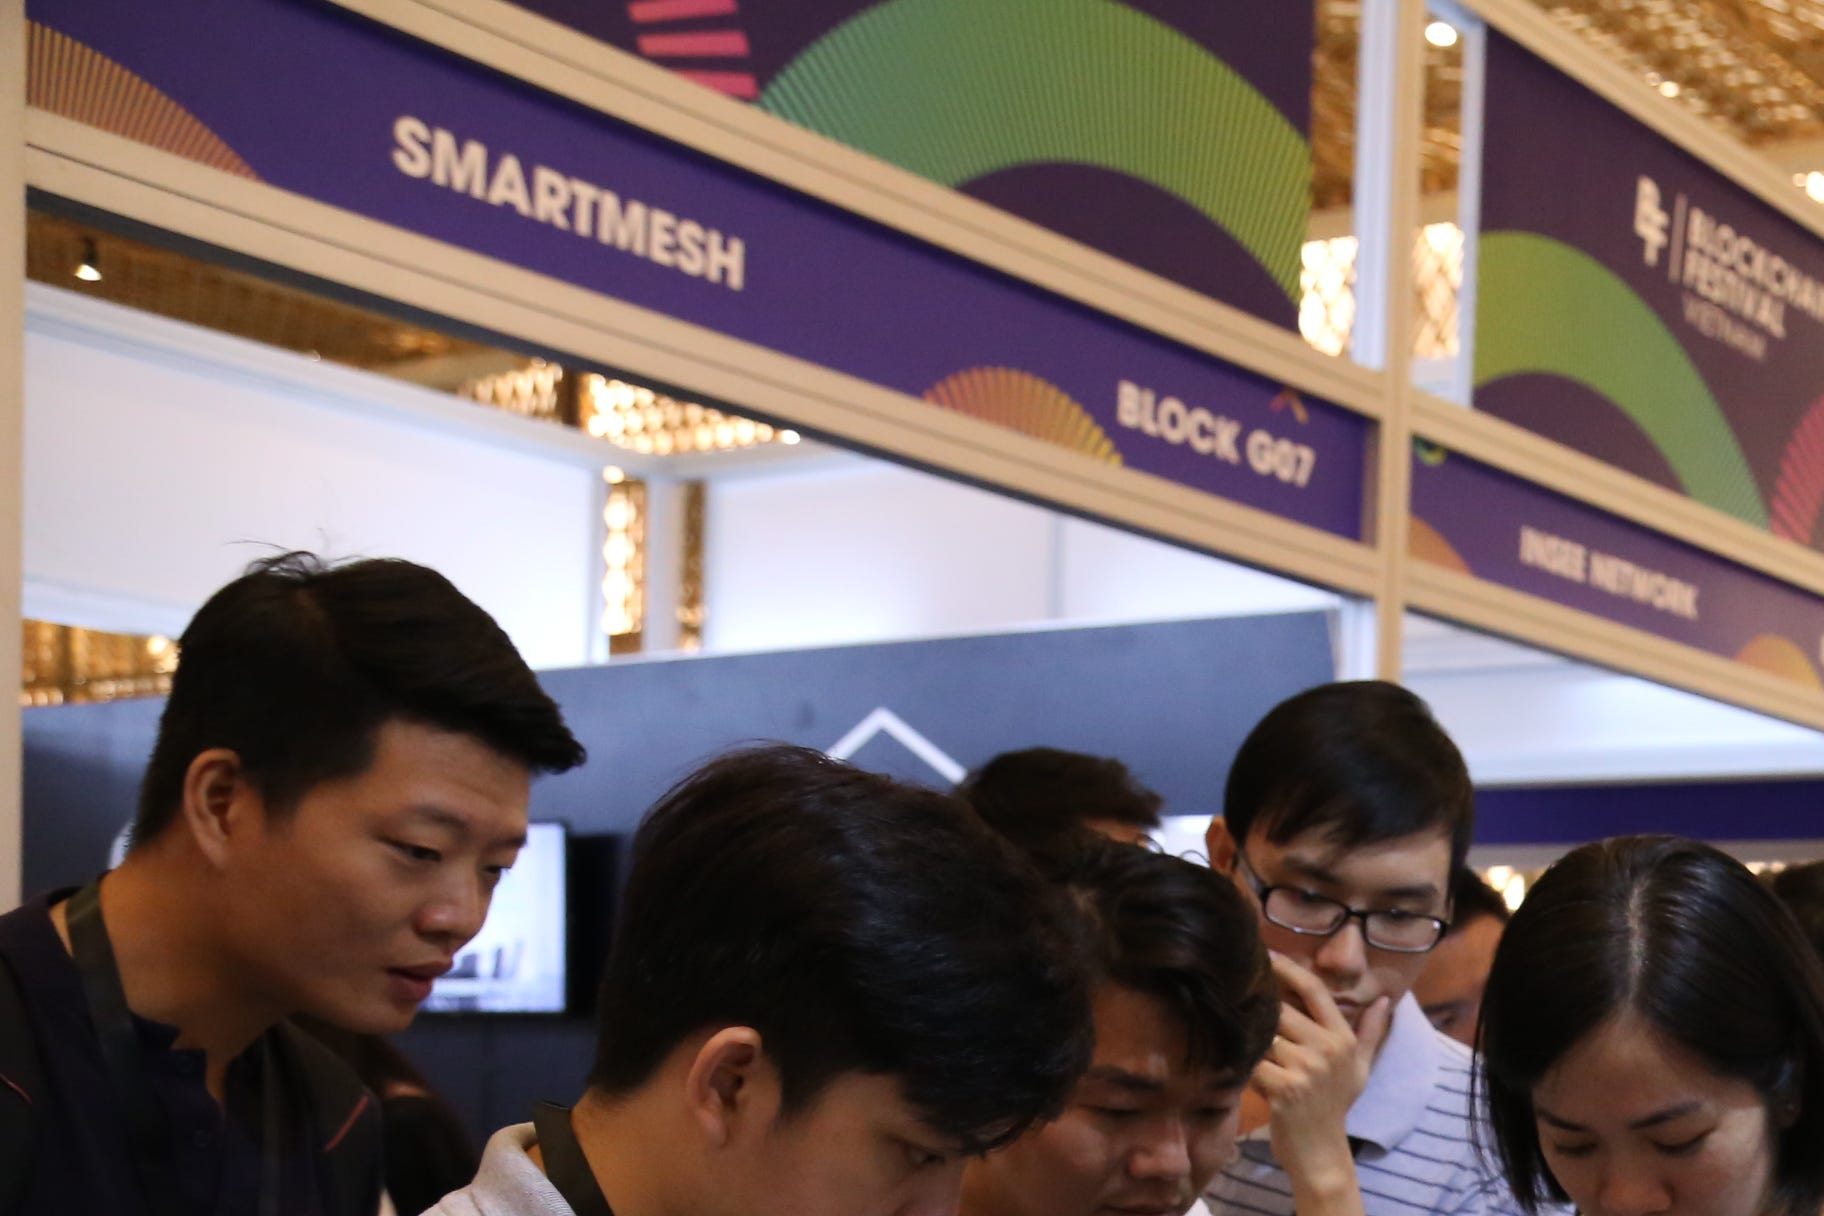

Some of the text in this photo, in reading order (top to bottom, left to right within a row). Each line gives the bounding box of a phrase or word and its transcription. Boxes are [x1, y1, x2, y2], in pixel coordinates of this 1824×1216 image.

[392, 115, 746, 292] SMARTMESH
[1683, 249, 1786, 339] FESTIVAL
[1116, 378, 1316, 489] BLOCK G07
